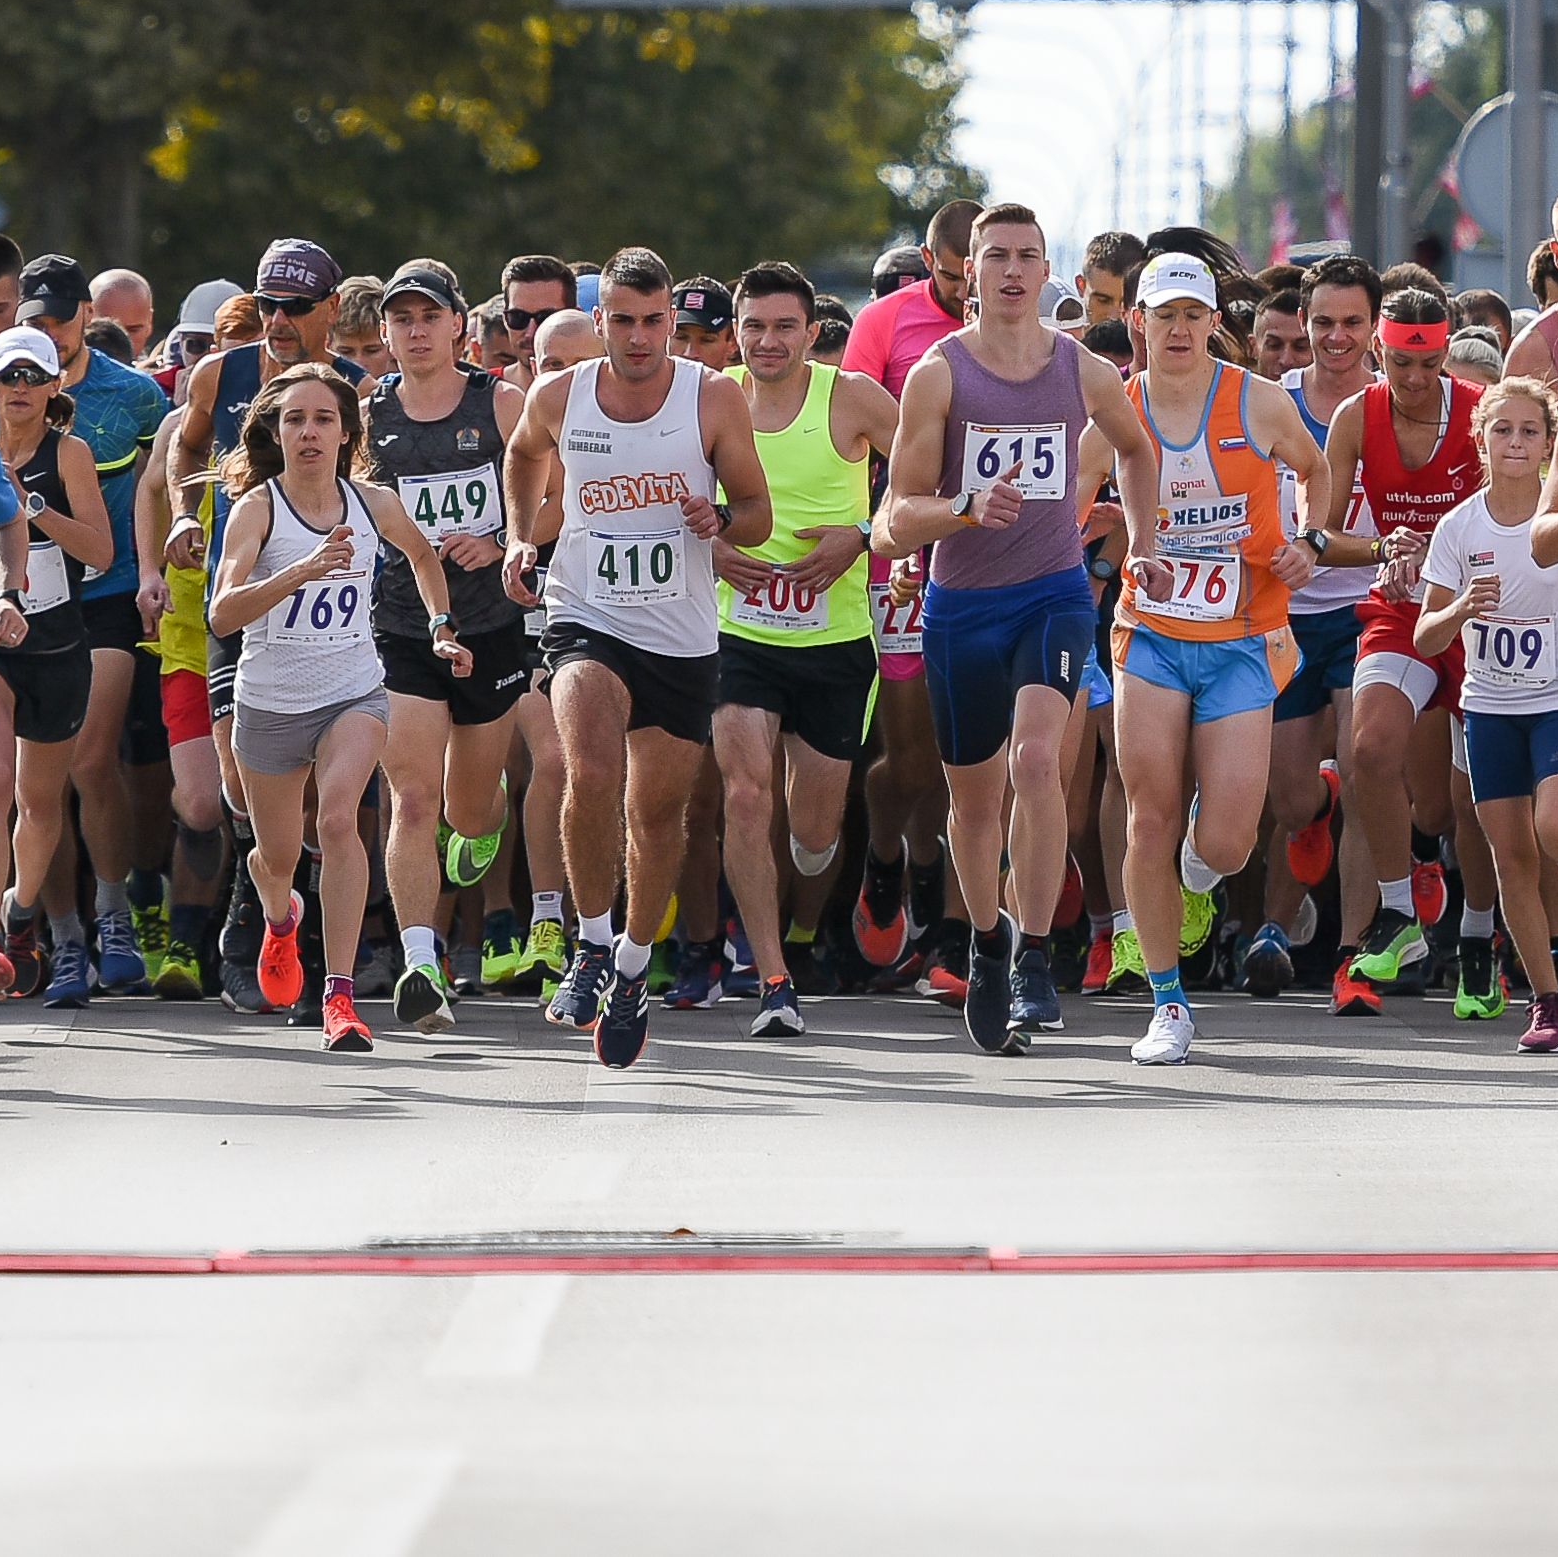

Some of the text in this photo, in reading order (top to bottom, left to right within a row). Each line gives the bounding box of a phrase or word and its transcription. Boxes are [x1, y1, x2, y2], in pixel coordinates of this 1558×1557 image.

[976, 436, 1054, 480] 615
[414, 480, 487, 527] 449
[579, 471, 690, 515] CEDEVITA
[1170, 479, 1206, 491] Donat
[1386, 492, 1455, 504] utrka.com
[1174, 502, 1243, 526] HELIOS
[597, 542, 673, 586] 410
[743, 573, 816, 613] 200
[1471, 622, 1543, 669] 709
